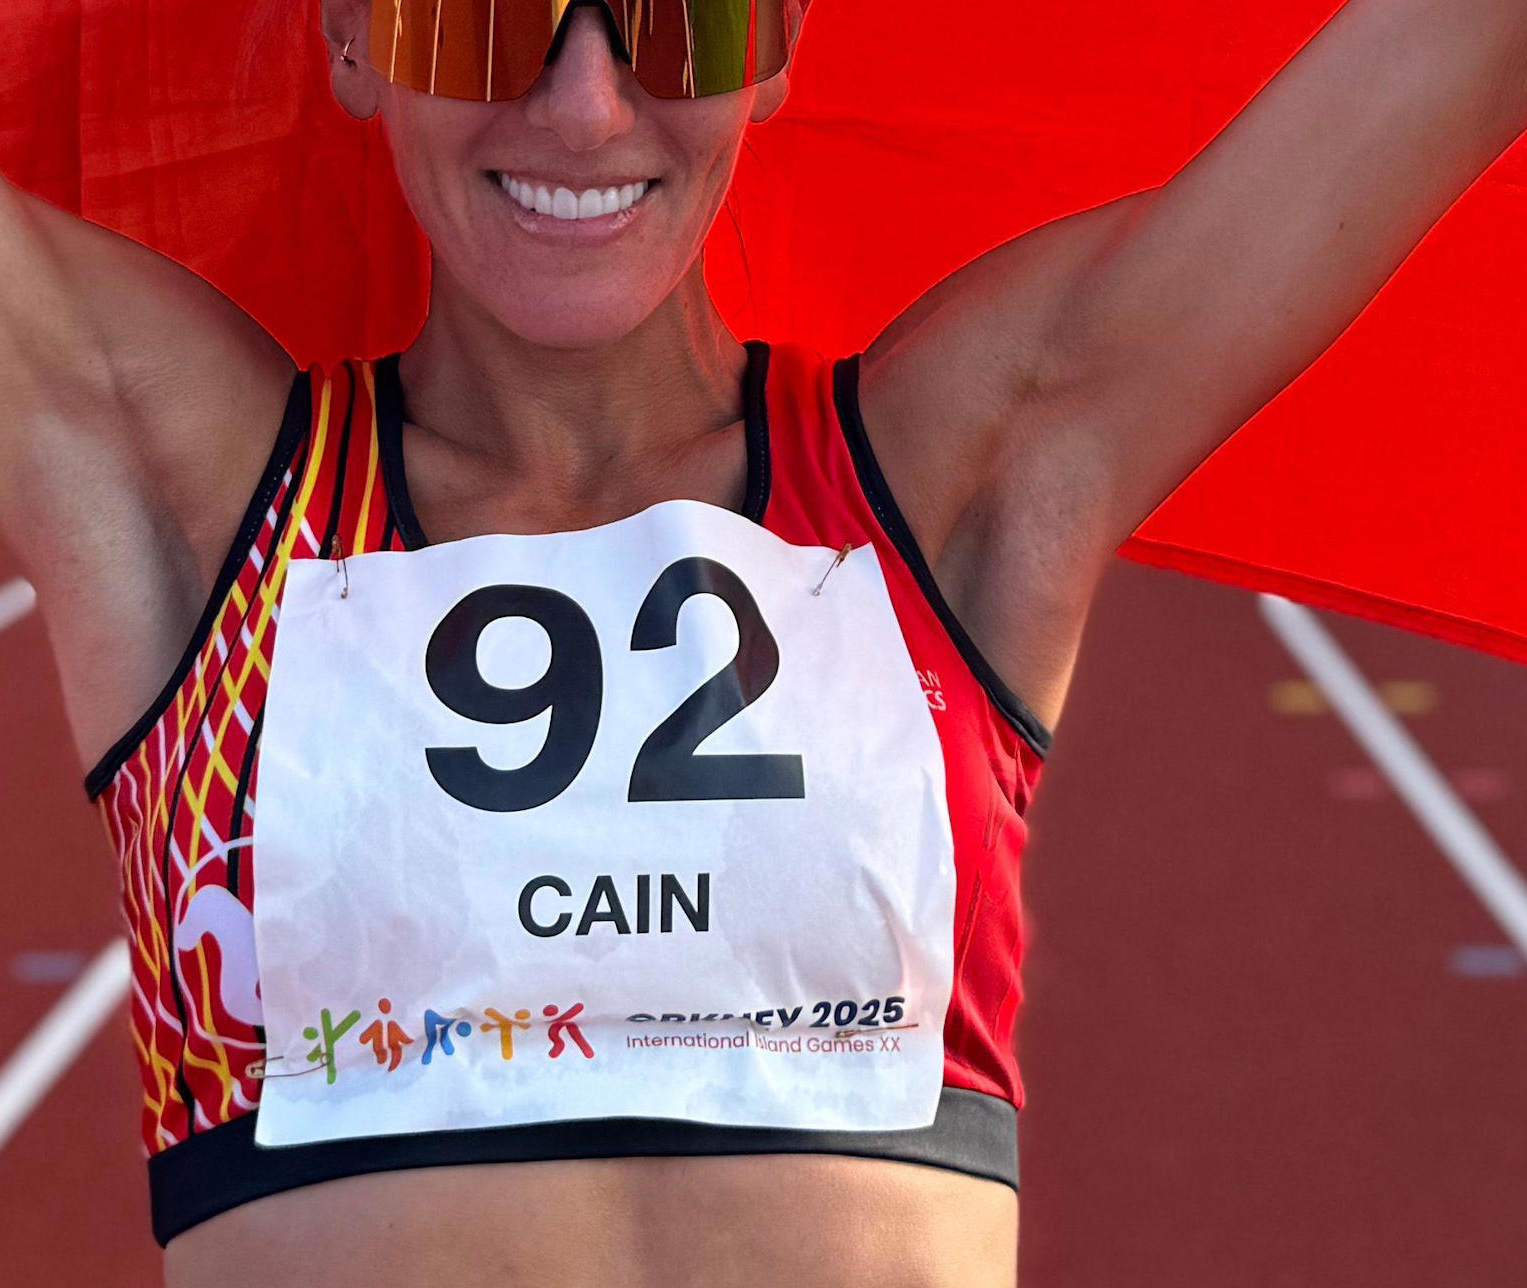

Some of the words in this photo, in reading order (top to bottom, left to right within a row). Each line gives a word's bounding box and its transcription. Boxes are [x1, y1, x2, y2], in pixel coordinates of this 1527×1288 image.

[425, 556, 806, 812] 92
[517, 872, 711, 938] CAIN
[809, 996, 905, 1028] 2025
[626, 1031, 750, 1050] International
[806, 1036, 875, 1054] Games
[880, 1036, 901, 1053] XX
